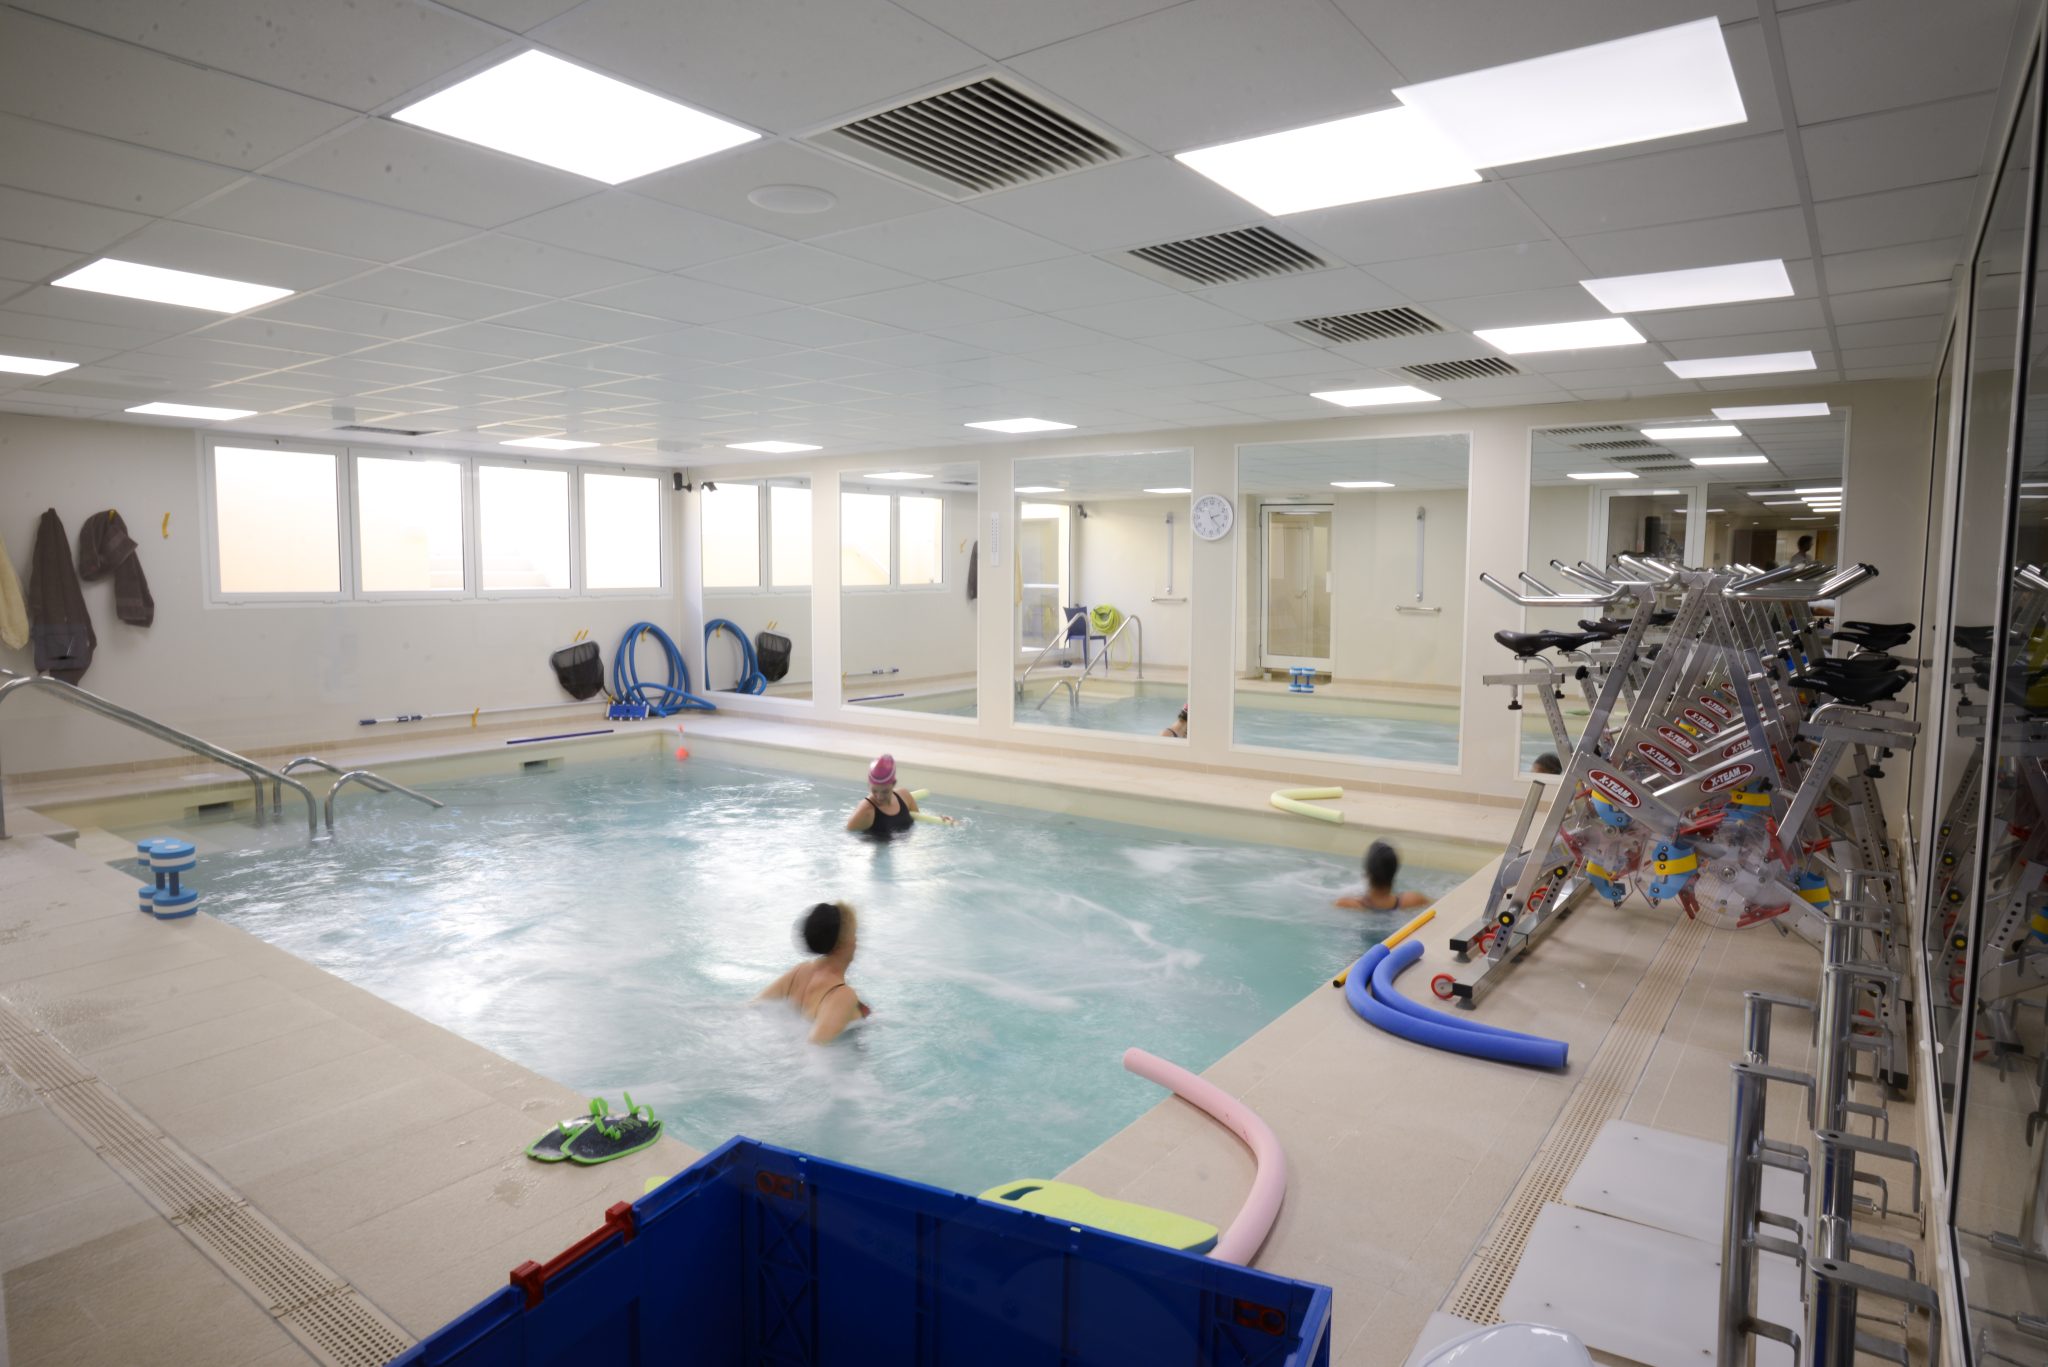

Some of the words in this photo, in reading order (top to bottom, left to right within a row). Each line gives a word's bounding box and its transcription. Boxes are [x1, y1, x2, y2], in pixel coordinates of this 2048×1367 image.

[1666, 731, 1692, 748] X-TEAM
[1731, 739, 1753, 754] X-TEA
[1647, 747, 1675, 767] X-TEAM
[1711, 767, 1740, 787] X-TEAM
[1599, 776, 1631, 799] X-TEAM
